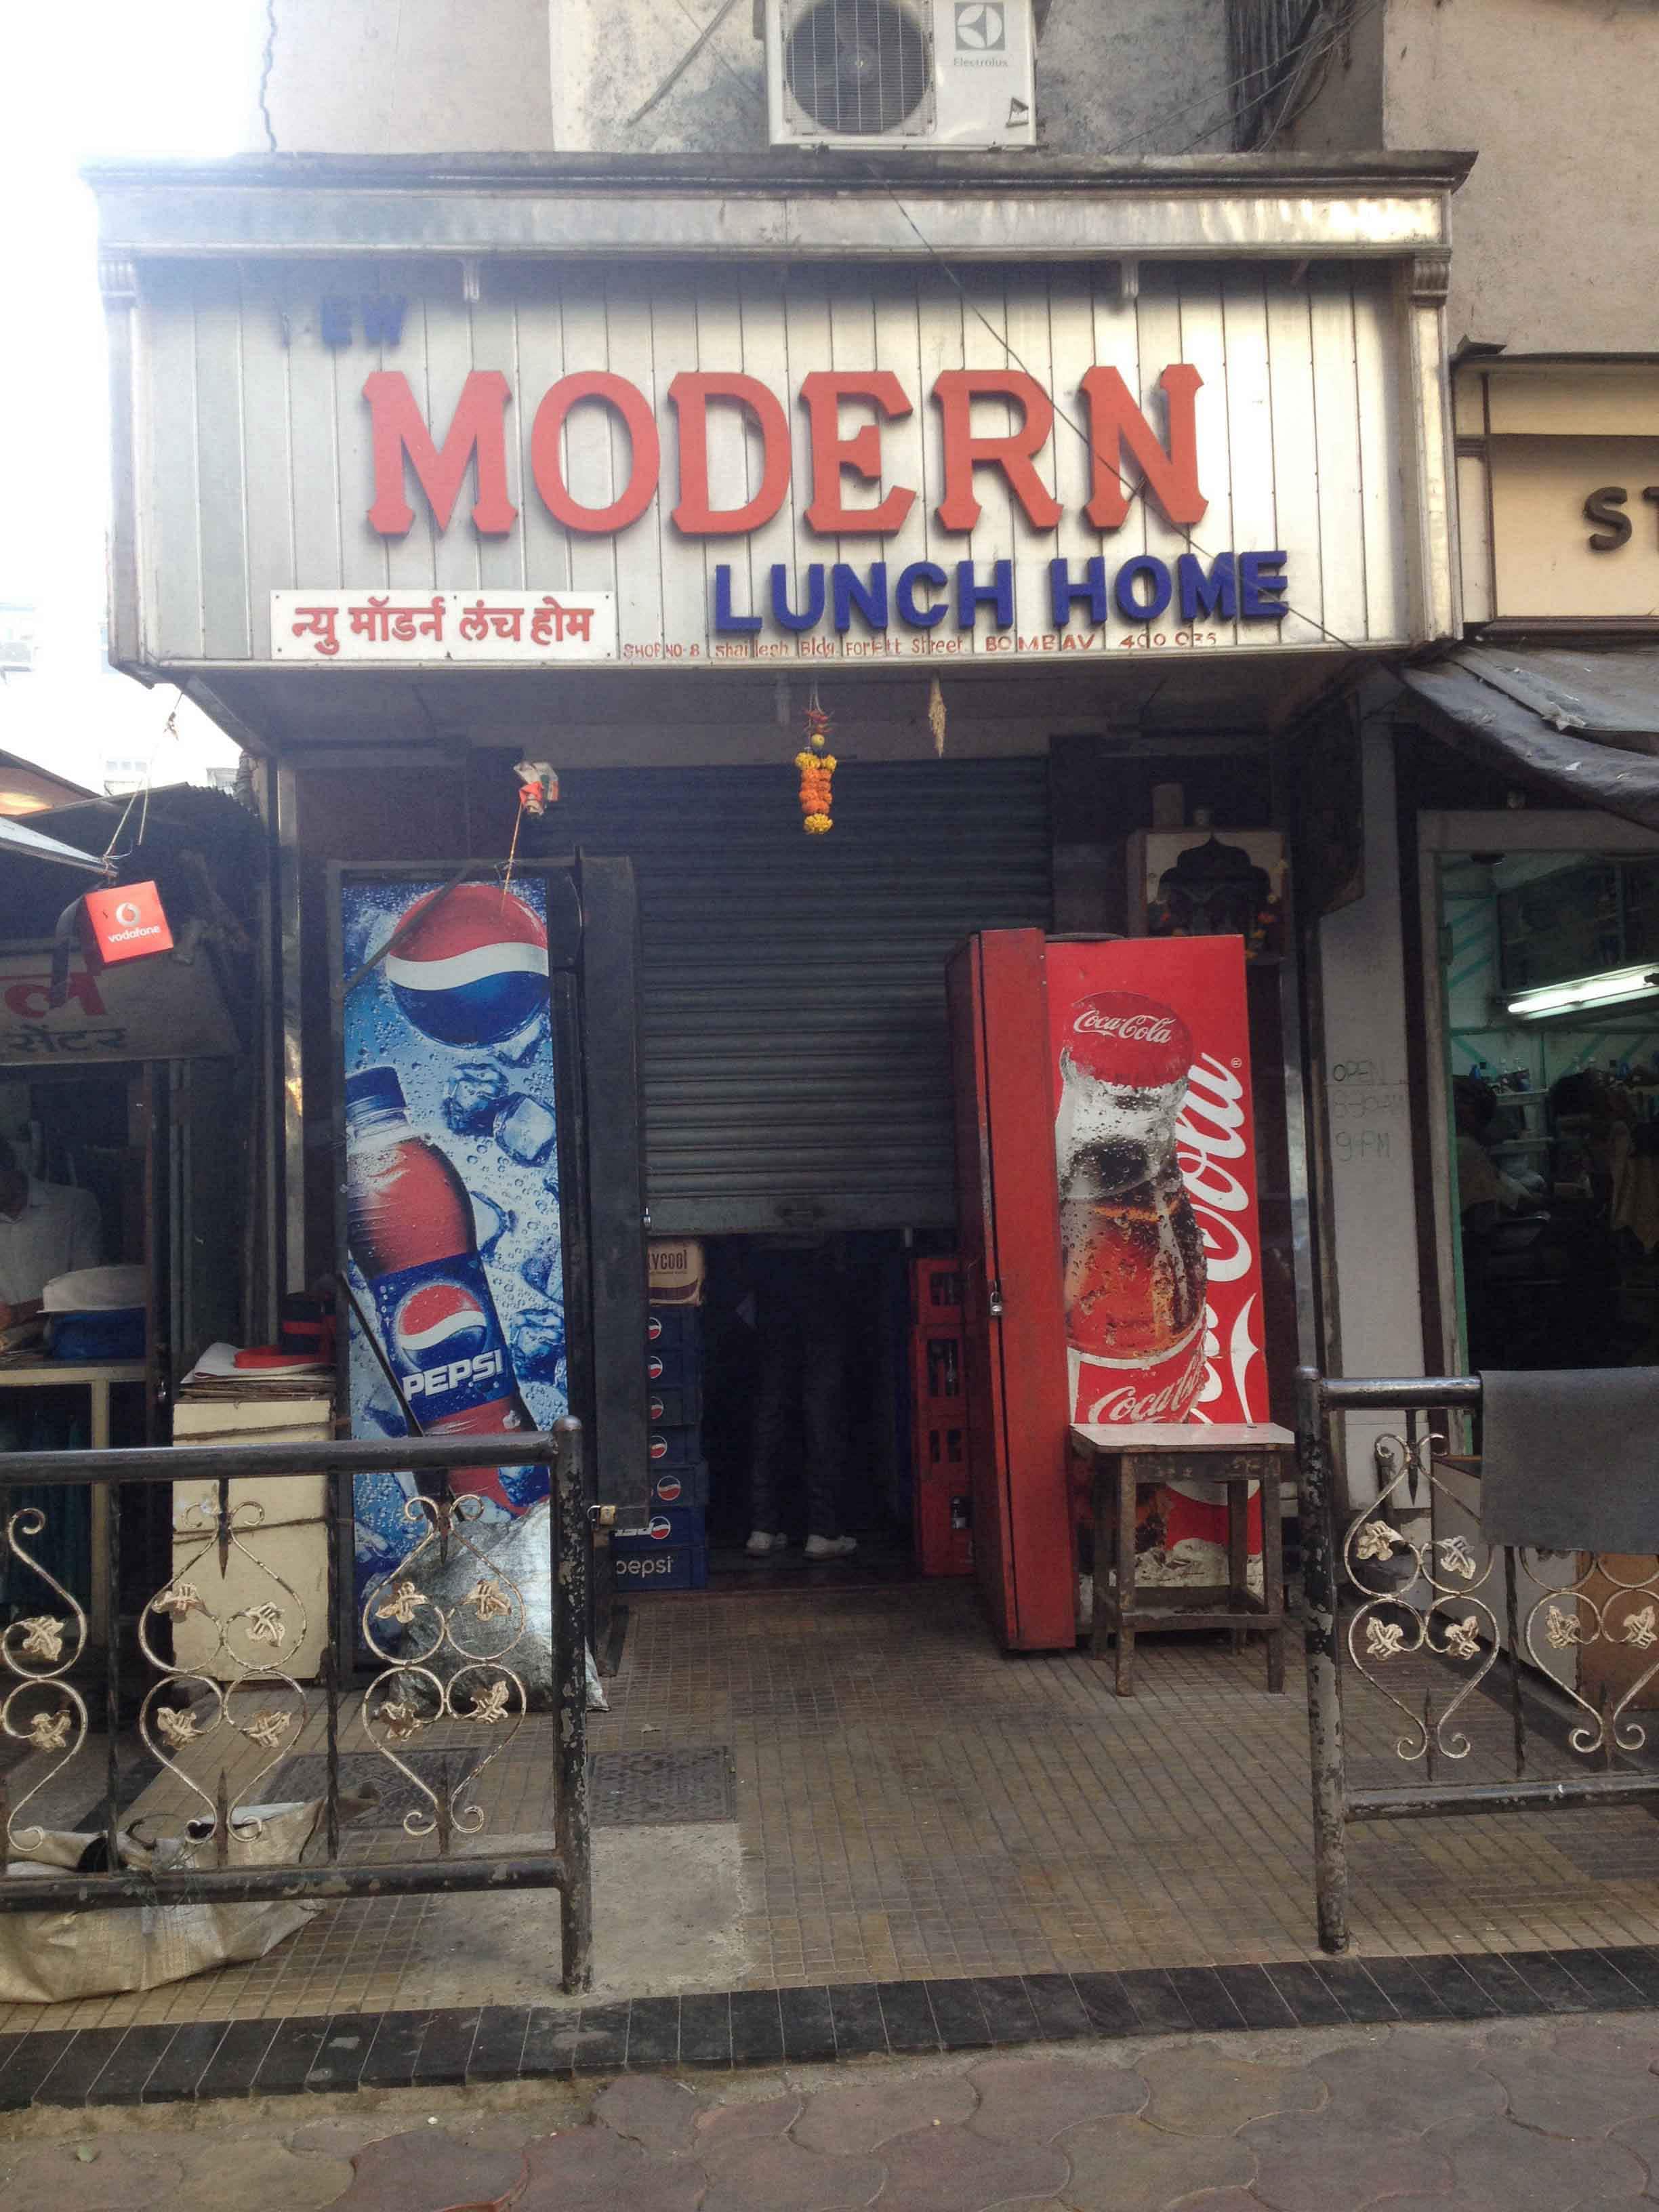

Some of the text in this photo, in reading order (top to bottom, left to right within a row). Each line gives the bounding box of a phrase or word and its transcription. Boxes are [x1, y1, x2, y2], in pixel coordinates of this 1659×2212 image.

[954, 58, 1008, 67] Electrolux
[361, 363, 1209, 536] MODERN
[715, 550, 1290, 633] LUNCH HOME
[348, 596, 447, 642] मॉडर्न
[459, 599, 525, 642] लंच
[530, 596, 594, 646] होम
[108, 924, 161, 944] vodafone
[1073, 1009, 1176, 1044] Coca-Cola
[401, 1349, 504, 1401] PEPSI
[615, 1555, 673, 1578] pepsi
